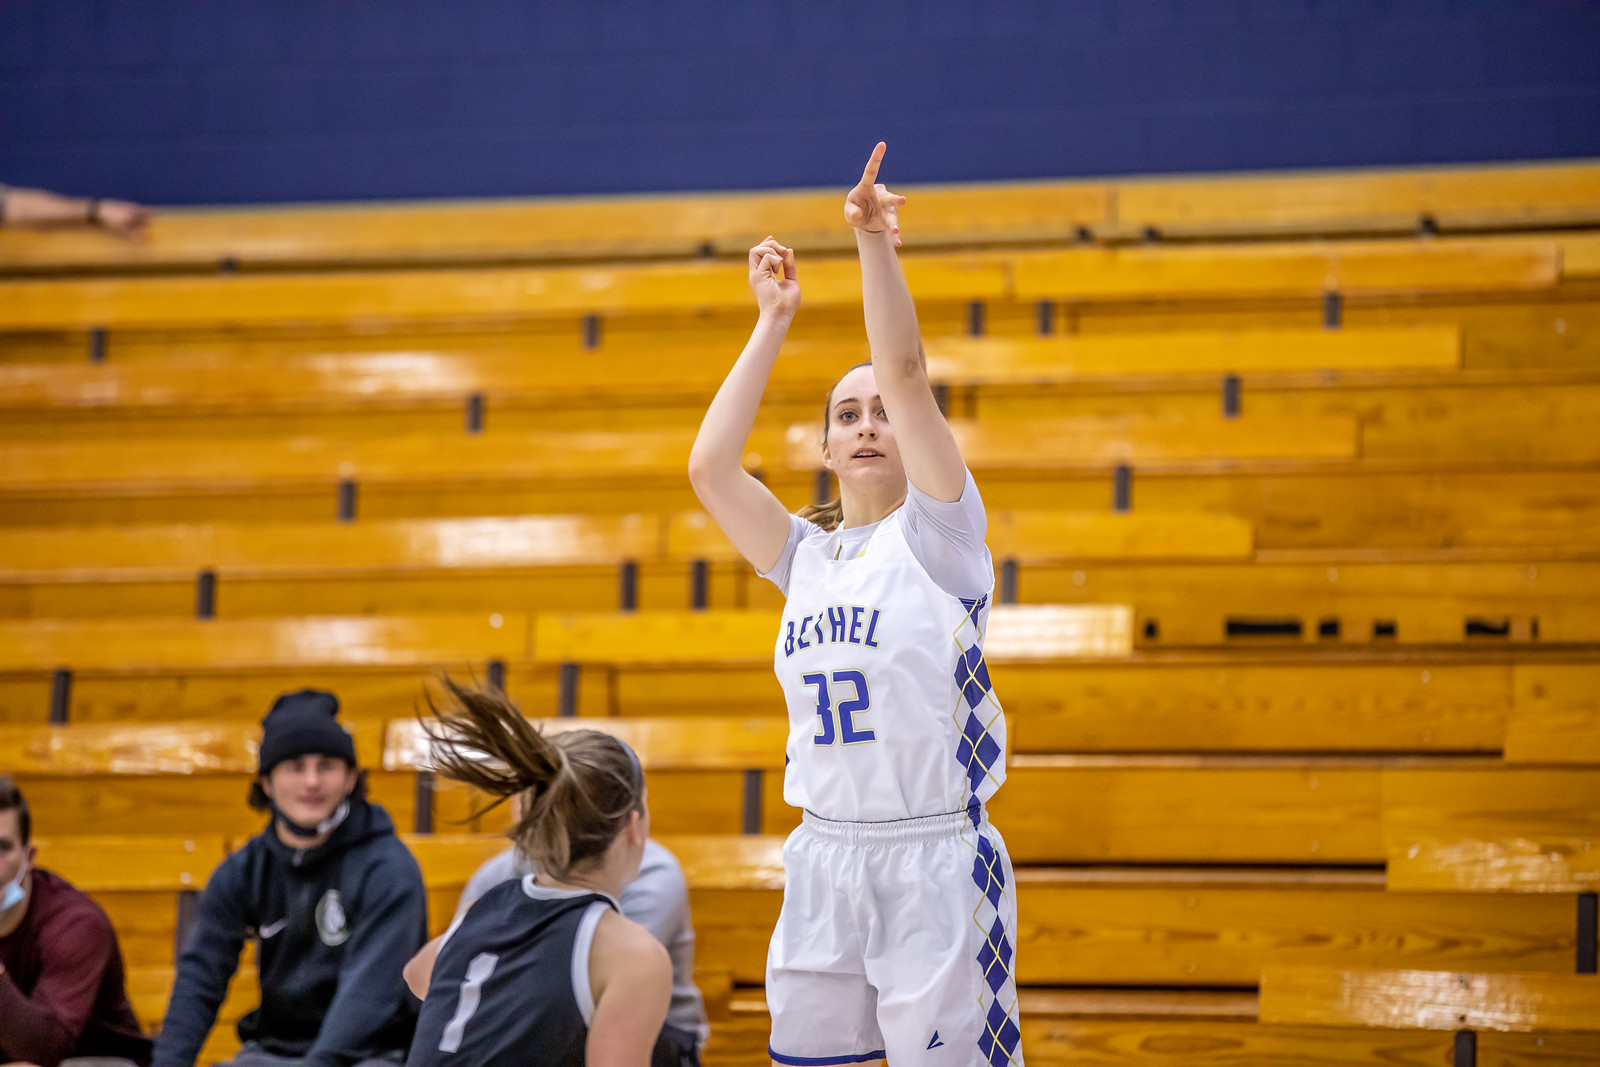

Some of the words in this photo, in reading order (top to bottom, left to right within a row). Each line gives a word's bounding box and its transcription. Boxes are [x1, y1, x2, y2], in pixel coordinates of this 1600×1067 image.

[784, 605, 881, 658] BETHEL
[801, 668, 877, 747] 32
[438, 952, 499, 1053] 1
